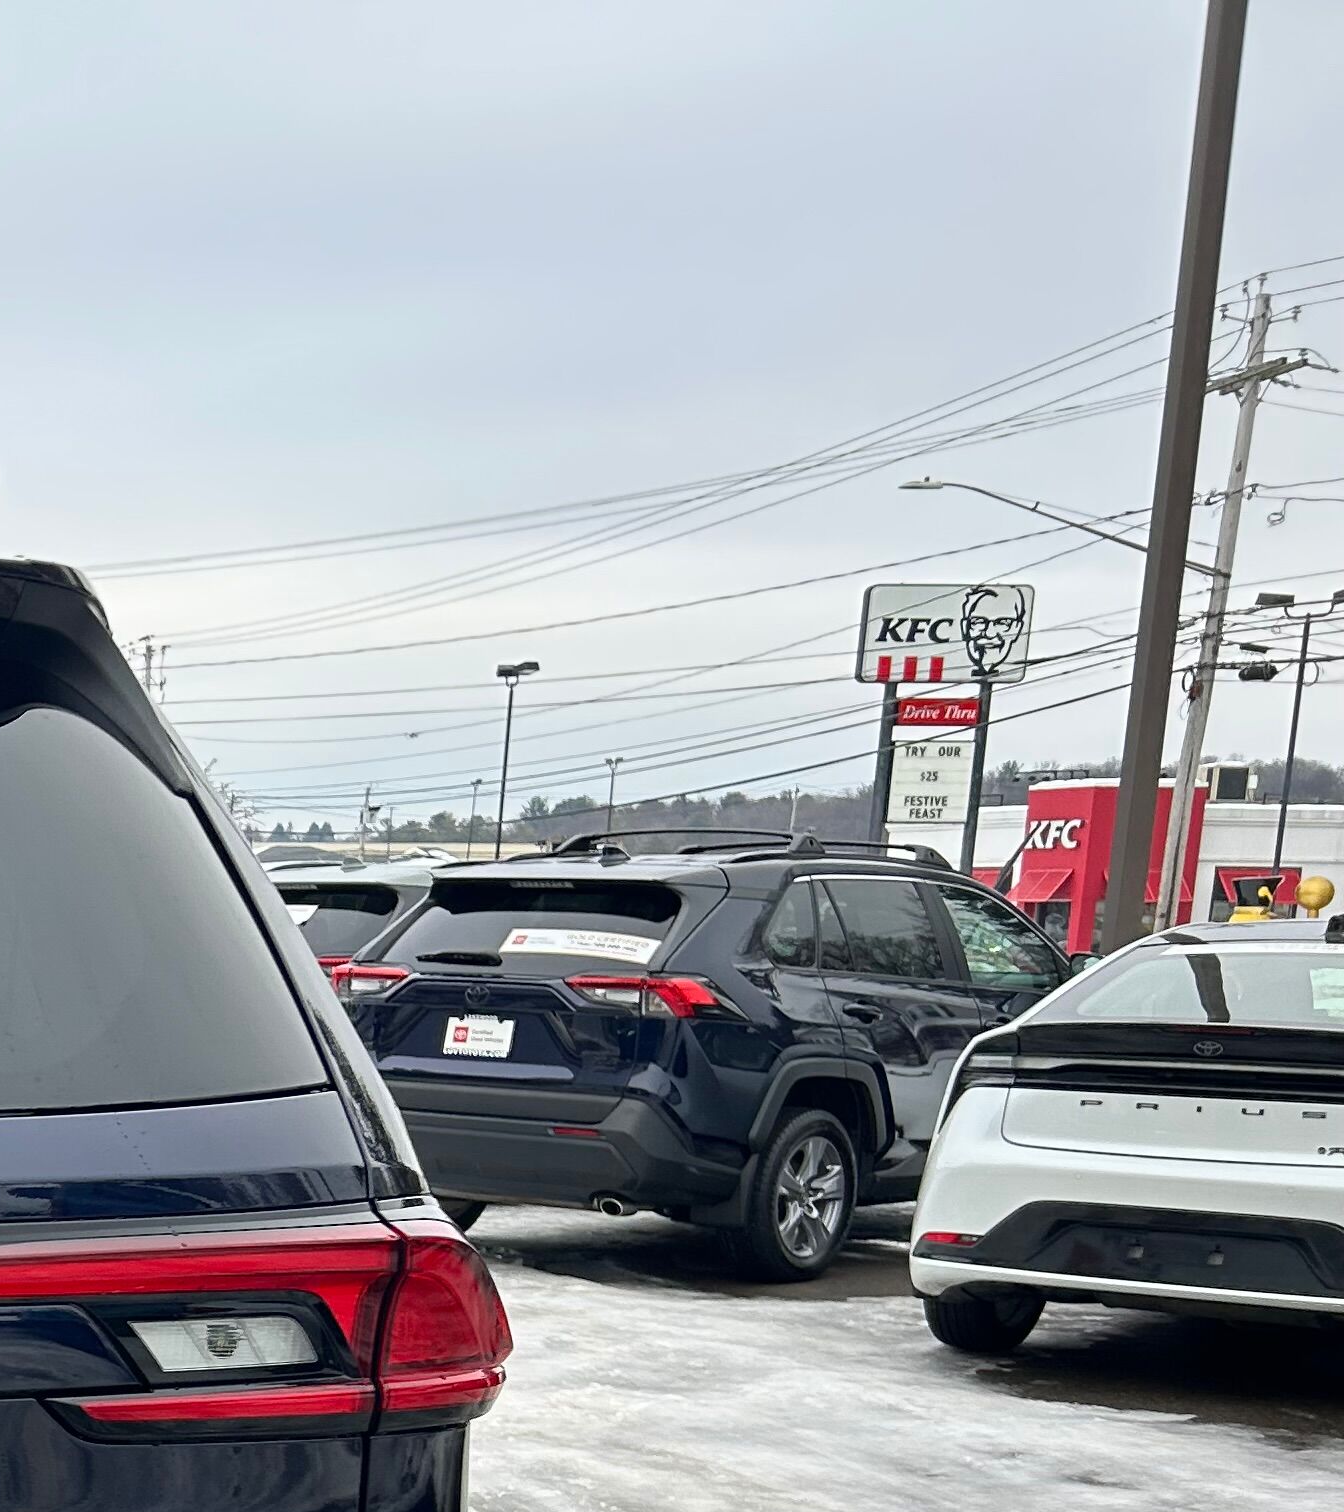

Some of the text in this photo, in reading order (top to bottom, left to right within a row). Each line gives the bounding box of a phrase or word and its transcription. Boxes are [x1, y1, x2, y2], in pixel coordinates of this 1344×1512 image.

[875, 617, 954, 643] KFC
[903, 704, 978, 720] Drive Thru
[904, 746, 961, 758] TRY OUR
[920, 771, 939, 782] $25
[904, 796, 949, 807] FESTIVE
[909, 808, 944, 819] FEAST
[1024, 818, 1083, 849] KFC
[1080, 1099, 1327, 1119] PRIUS
